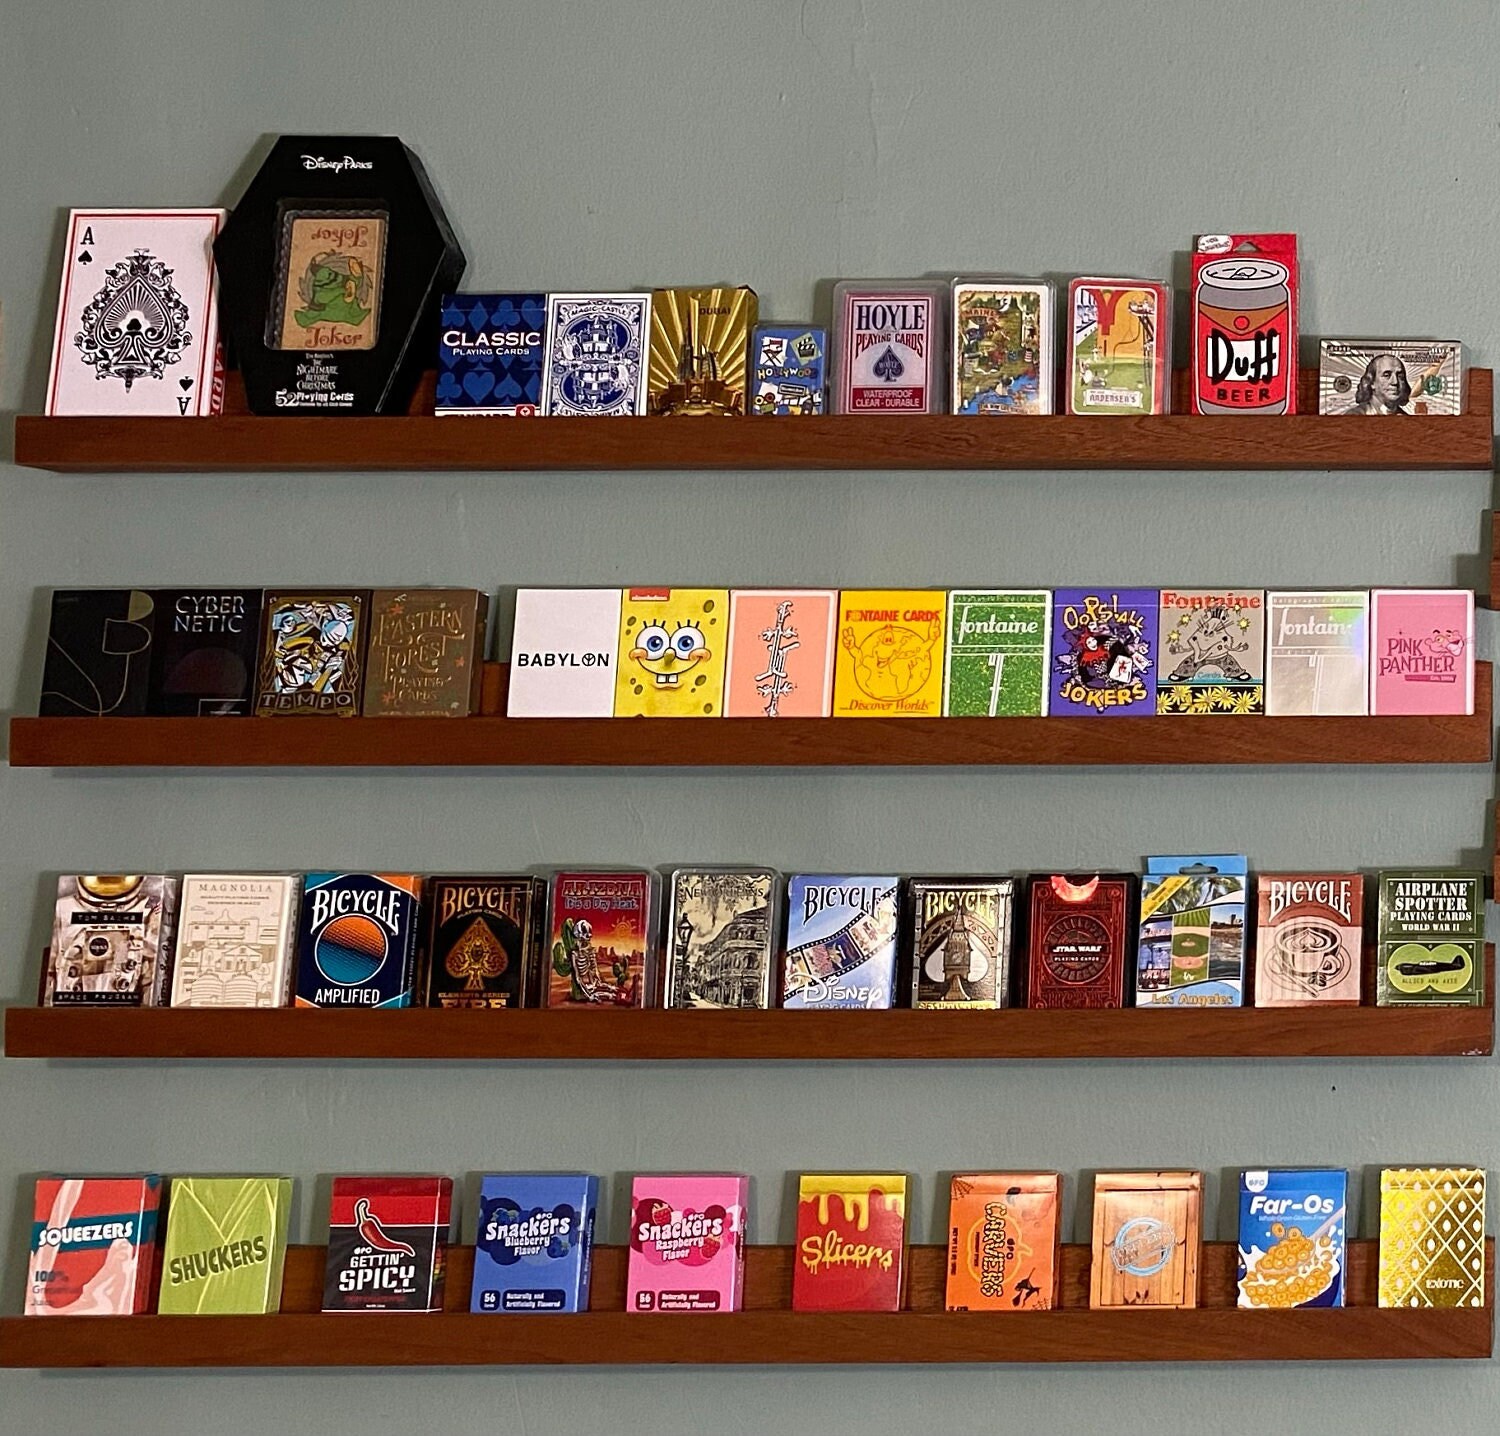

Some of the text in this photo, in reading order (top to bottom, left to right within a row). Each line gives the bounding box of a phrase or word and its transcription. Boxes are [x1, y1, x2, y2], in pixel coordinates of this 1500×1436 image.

[80, 226, 95, 246] A
[311, 225, 369, 248] Joker
[571, 305, 629, 317] MAGIC CASTLE
[855, 304, 925, 331] HOYLE
[305, 326, 362, 348] Joker
[443, 330, 541, 349] CLASSIC
[452, 347, 530, 357] PLAYING CARDS
[856, 333, 925, 359] PLAYING CARDS
[1210, 327, 1280, 386] Duff
[296, 364, 339, 376] NIGHTMARE
[757, 368, 818, 380] HOLLYWOOD
[296, 380, 336, 390] CHRISTMAS
[275, 388, 299, 407] 52
[863, 389, 913, 399] WATERPROOF
[1217, 388, 1271, 403] BEER
[177, 396, 192, 416] A
[855, 400, 920, 408] CLEAR DURABLE
[175, 596, 245, 615] CYBER
[1162, 592, 1261, 609] Fontaine
[173, 615, 244, 633] NETIC
[845, 609, 939, 622] FONTAINE CARDS
[958, 605, 1038, 644] fontaine
[1387, 637, 1424, 657] PINK
[1379, 655, 1455, 677] PANTHER
[262, 692, 352, 709] TEMPO
[1059, 683, 1149, 709] JOKERS
[848, 699, 931, 711] Discover Worlds
[199, 883, 273, 892] MAGNOLIA
[562, 880, 642, 897] ARIZONA
[1395, 882, 1467, 897] AIRPLANE
[440, 887, 521, 928] BICYCLE
[802, 886, 883, 927] BICYCLE
[925, 891, 997, 929] BICYCLE
[1269, 881, 1351, 923] BICYCLE
[1394, 897, 1468, 911] SPOTTER
[311, 889, 401, 935] BICYCLE
[1390, 911, 1472, 921] PLAYING CARDS
[1401, 923, 1460, 931] WORLD WAR II
[314, 988, 380, 1004] AMPLIFIED
[1152, 993, 1234, 1007] Los Angeles
[1250, 1194, 1335, 1214] Far-Os
[39, 1221, 133, 1246] SQUEEZERS
[485, 1217, 571, 1241] Snackers
[639, 1218, 723, 1241] Snackers
[505, 1236, 551, 1247] Blueberry
[656, 1236, 705, 1250] Raspberry
[981, 1201, 1008, 1297] CARVERS
[514, 1246, 540, 1256] Flavor
[662, 1249, 690, 1260] Flavor
[801, 1229, 894, 1275] Slicers
[169, 1236, 268, 1285] SHUCKERS
[350, 1253, 405, 1268] GETTIN'
[338, 1265, 415, 1291] SPICY
[1425, 1277, 1466, 1290] EXOTIC
[484, 1293, 496, 1302] 56
[639, 1293, 651, 1303] 56
